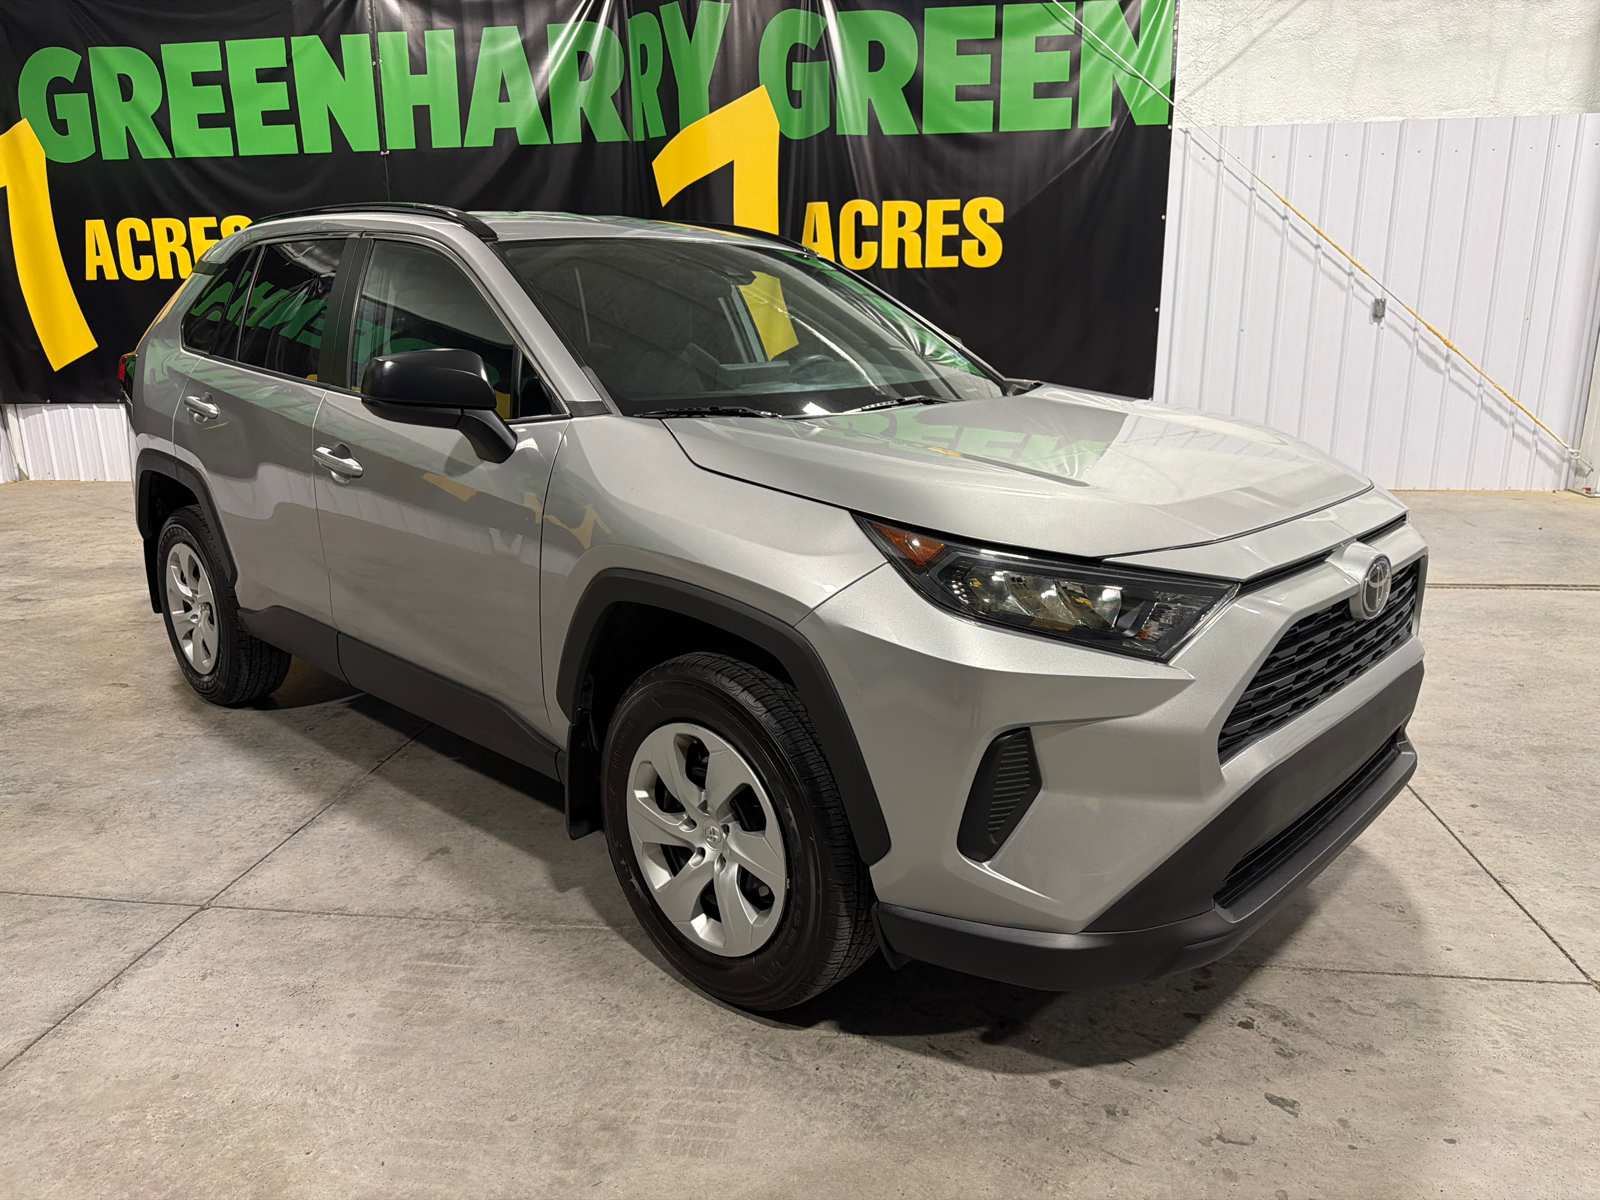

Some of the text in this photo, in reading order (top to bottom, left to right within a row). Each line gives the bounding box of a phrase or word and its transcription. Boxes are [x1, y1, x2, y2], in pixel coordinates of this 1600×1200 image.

[18, 33, 380, 163] GREEN
[377, 0, 1176, 150] HARRY GREEN
[84, 214, 253, 281] ACRE
[801, 196, 1004, 271] ACRES
